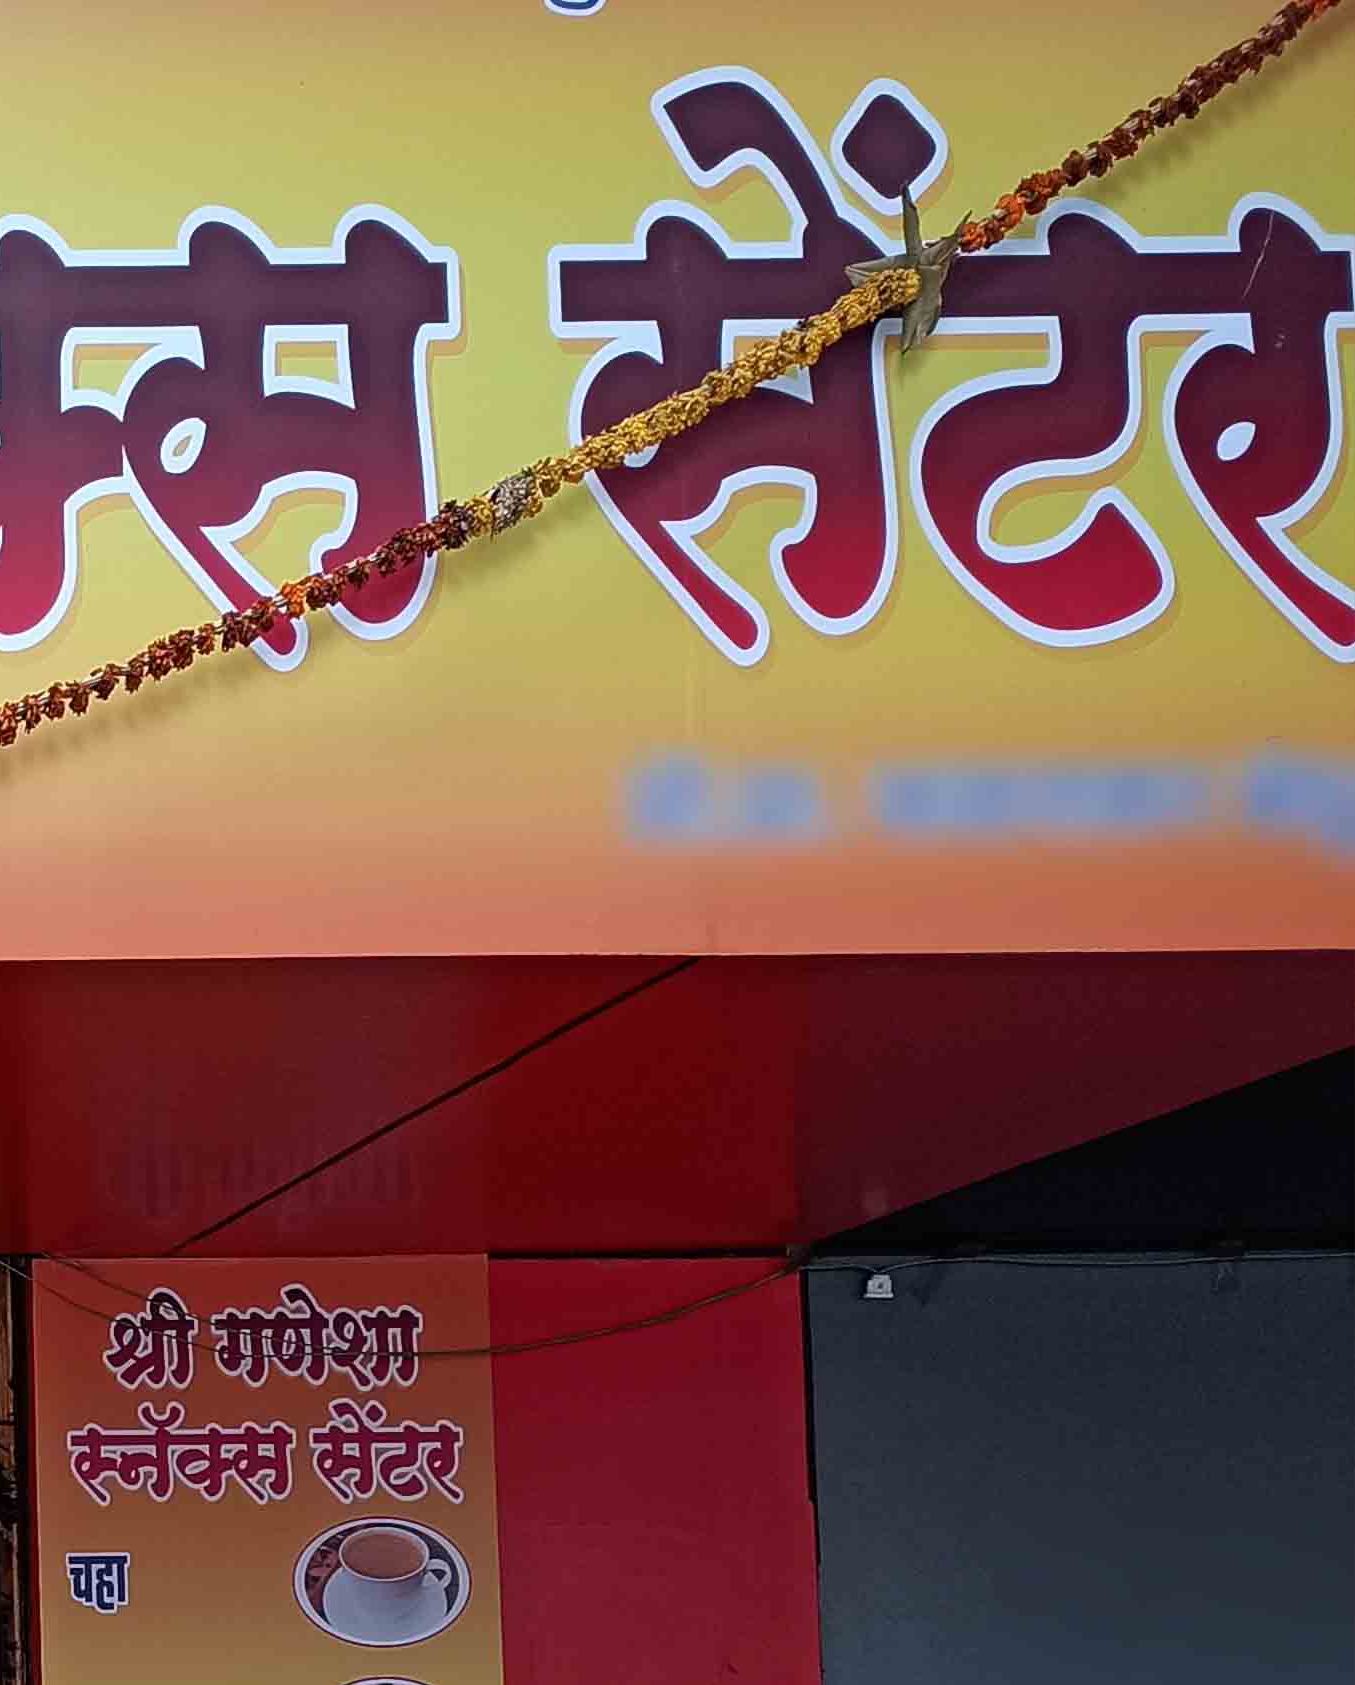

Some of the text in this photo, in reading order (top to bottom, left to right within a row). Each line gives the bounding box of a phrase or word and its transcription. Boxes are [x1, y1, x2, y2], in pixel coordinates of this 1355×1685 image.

[552, 66, 1355, 665] सेंटर
[104, 1283, 421, 1392] श्री गणेशा
[67, 1399, 464, 1505] स्नॅक्स सेंटर
[66, 1552, 130, 1613] चहा
